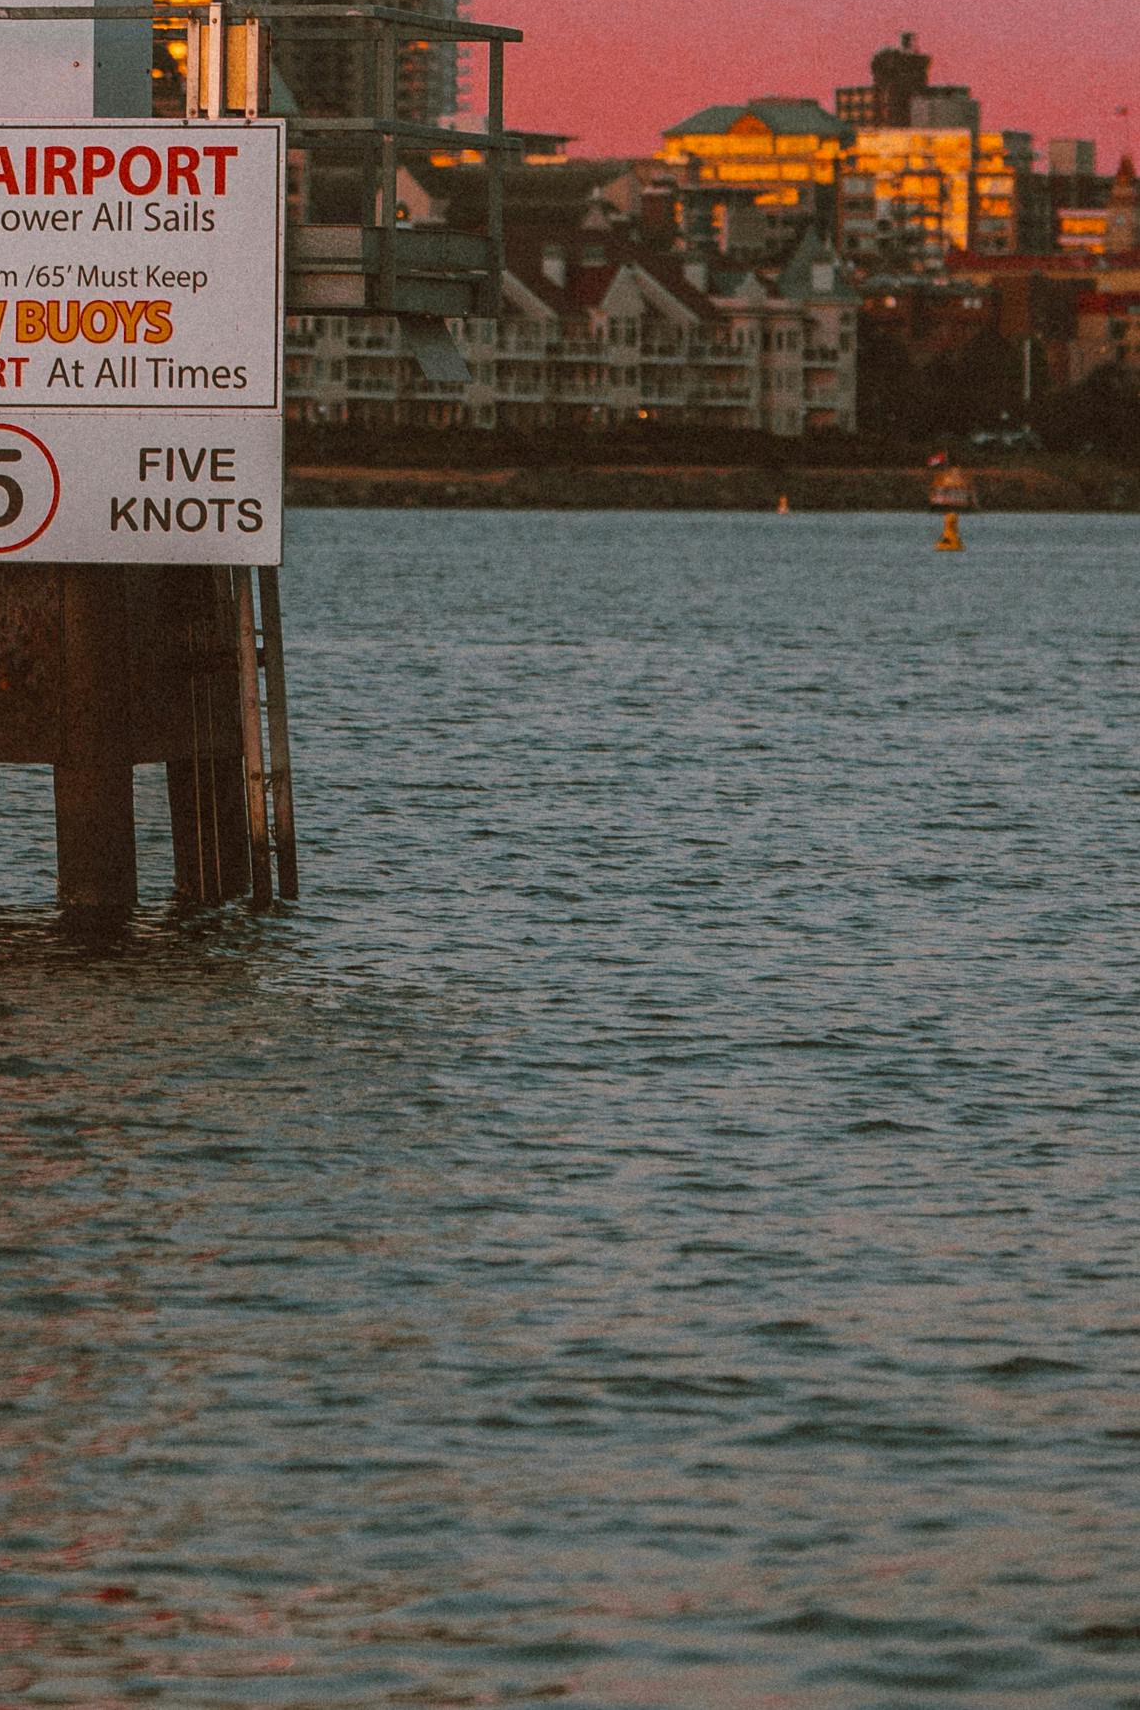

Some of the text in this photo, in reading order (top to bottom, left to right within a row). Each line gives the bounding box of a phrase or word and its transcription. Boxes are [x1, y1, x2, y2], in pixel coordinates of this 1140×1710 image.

[92, 203, 132, 231] All
[144, 202, 215, 232] Sails
[78, 266, 138, 288] Must
[146, 266, 208, 293] Keep
[15, 300, 172, 344] BUOYS
[47, 358, 83, 389] At
[95, 357, 136, 388] All
[146, 358, 248, 389] Times
[139, 448, 235, 482] FIVE
[111, 497, 262, 533] KNOTS
